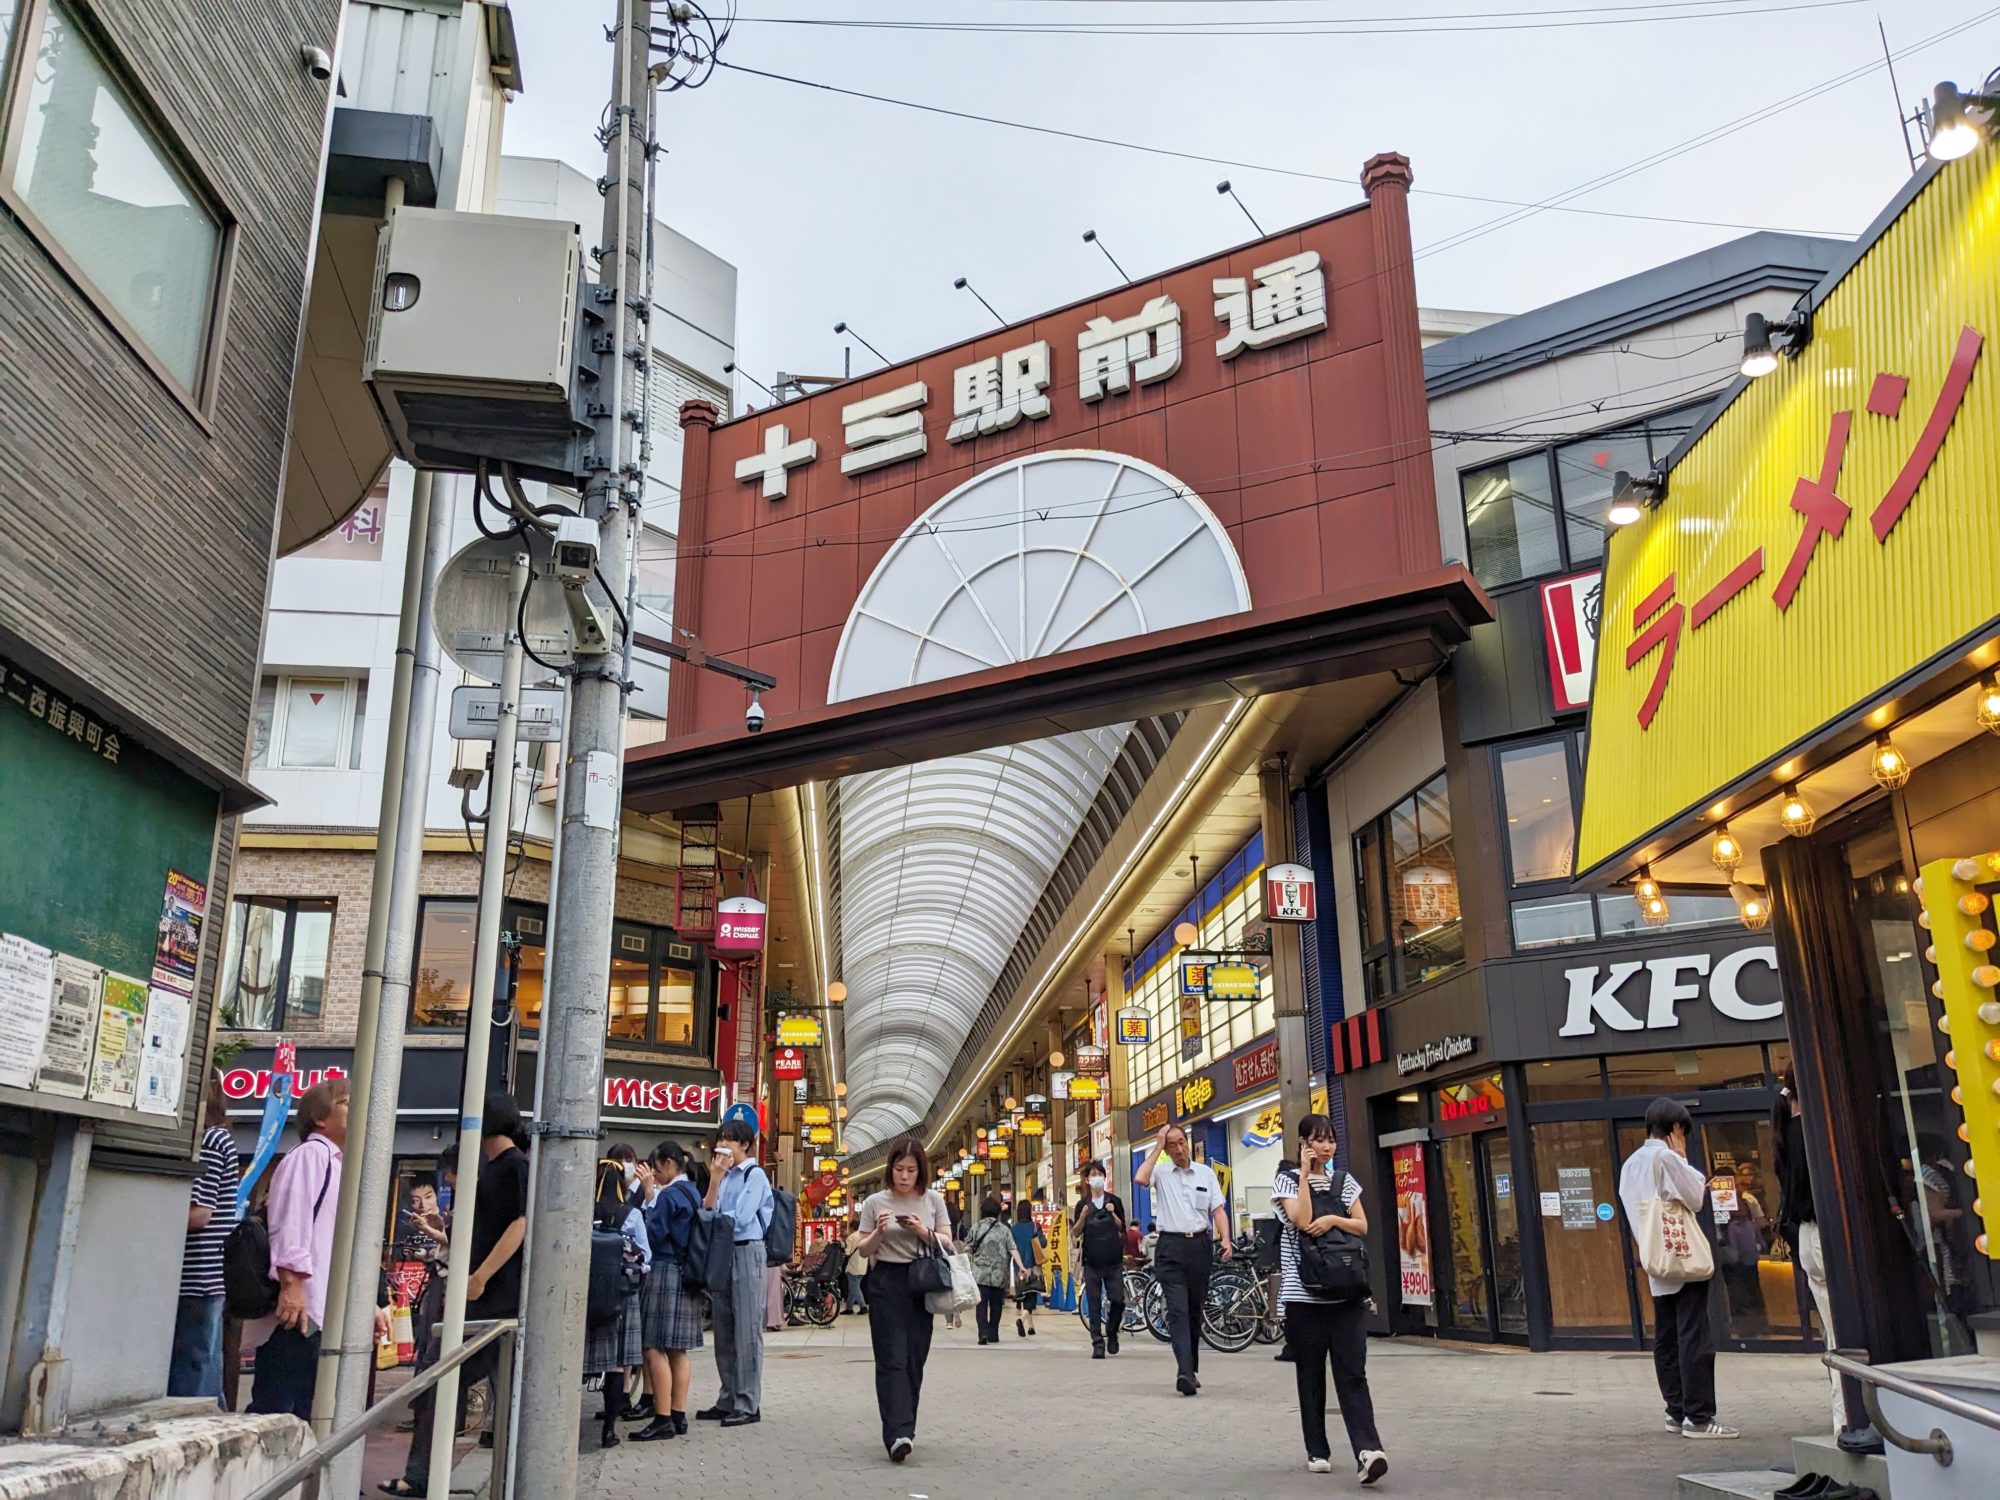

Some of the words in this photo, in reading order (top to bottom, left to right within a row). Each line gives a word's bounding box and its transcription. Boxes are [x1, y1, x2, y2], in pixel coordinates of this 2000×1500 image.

[733, 249, 1329, 500] 十三駅前通
[1625, 322, 1985, 731] ラーメン
[1282, 907, 1303, 916] KFC
[1558, 945, 1784, 1037] KFC
[1127, 1020, 1143, 1036] 薬
[1396, 1048, 1426, 1076] Kentucky
[1425, 1041, 1444, 1067] Fried
[1444, 1035, 1472, 1061] Chicken
[219, 1066, 347, 1099] onu
[1402, 1271, 1429, 1296] ¥990
